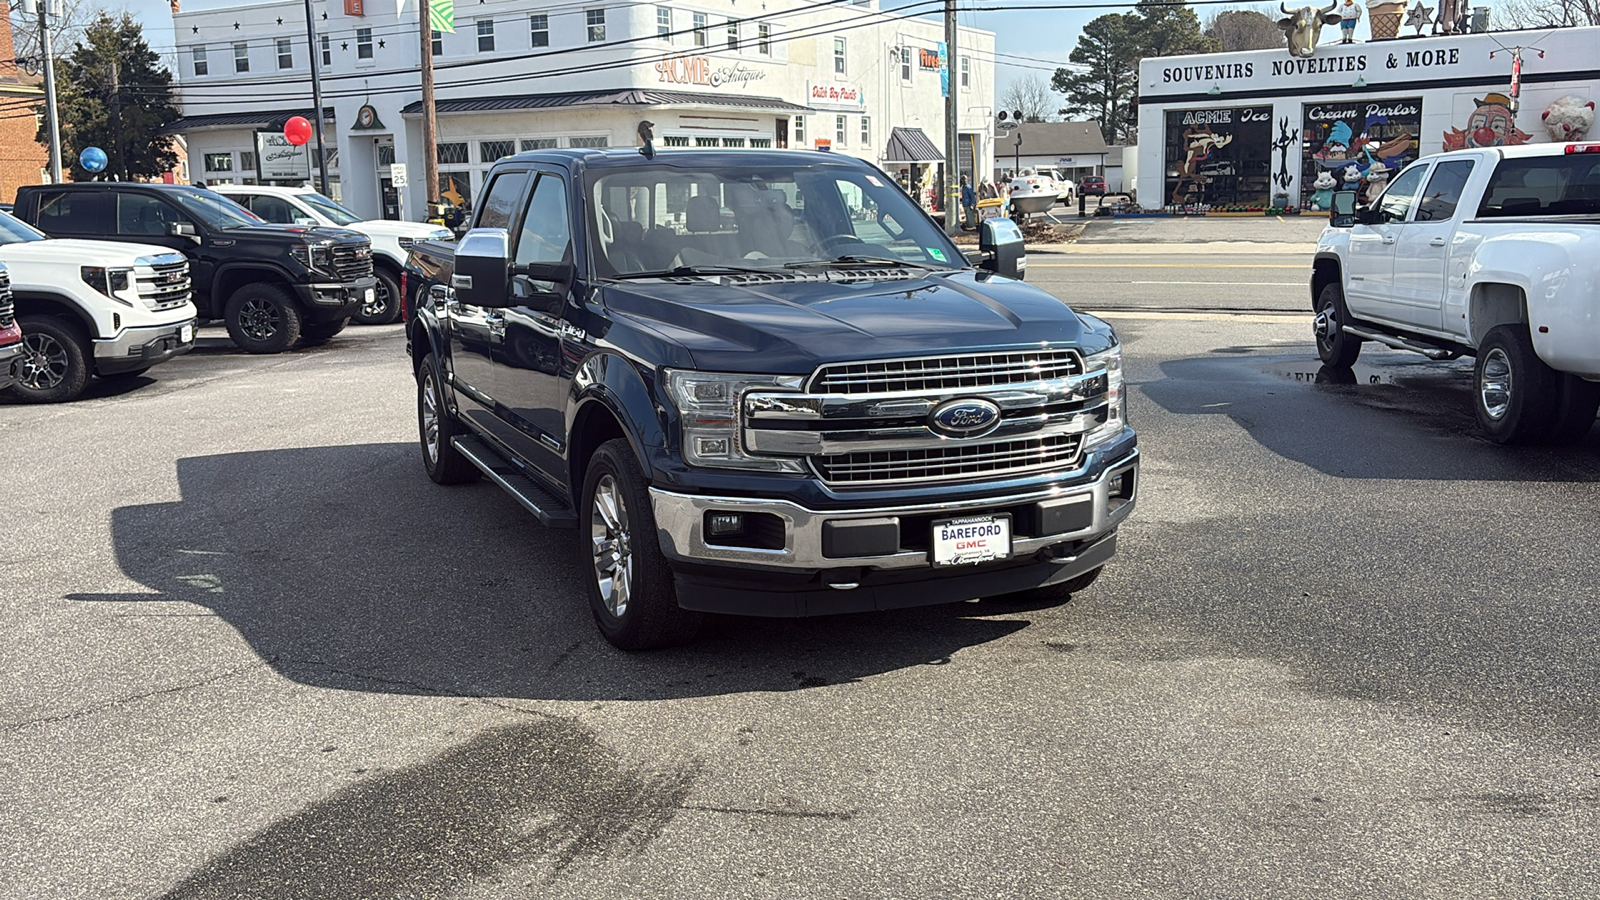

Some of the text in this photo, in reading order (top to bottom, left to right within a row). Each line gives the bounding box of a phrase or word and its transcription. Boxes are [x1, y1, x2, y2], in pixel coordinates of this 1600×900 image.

[655, 54, 710, 86] ACME
[1163, 49, 1459, 82] SOUVENIRS NOVELTIES & MORE
[812, 85, 857, 102] Dutch Boy Paints
[1182, 103, 1418, 125] ACME Ice Cream Parlor
[394, 175, 405, 184] 25
[950, 408, 984, 426] Ford
[951, 515, 993, 525] TAPPAHANNOCK
[941, 524, 1001, 541] BAREFORD
[956, 539, 987, 550] GMC
